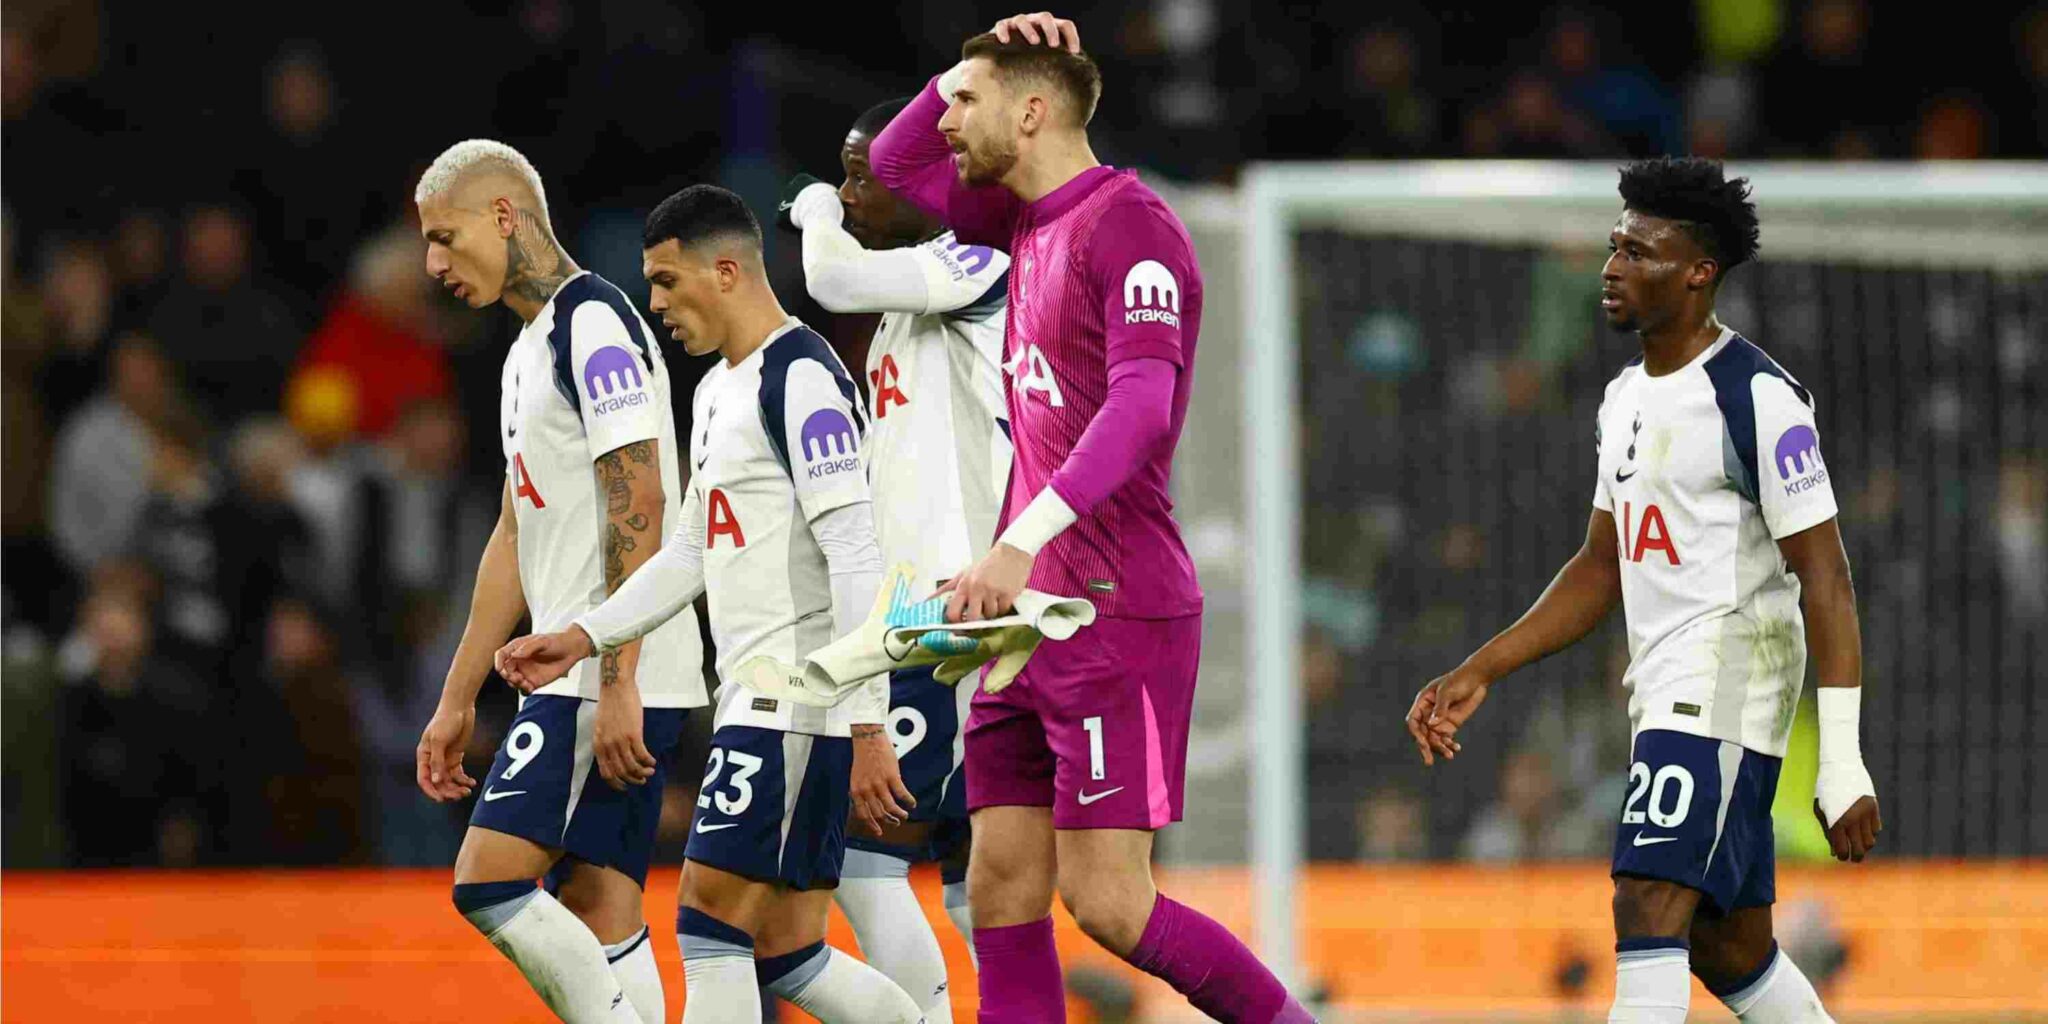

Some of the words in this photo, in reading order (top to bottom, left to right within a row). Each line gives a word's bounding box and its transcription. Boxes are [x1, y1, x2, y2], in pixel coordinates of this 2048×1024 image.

[593, 392, 649, 417] kraken
[1785, 470, 1826, 496] krake
[1619, 501, 1681, 565] IA
[501, 721, 544, 780] 9
[1083, 716, 1105, 780] 1
[697, 748, 763, 816] 23
[1622, 762, 1695, 828] 20
